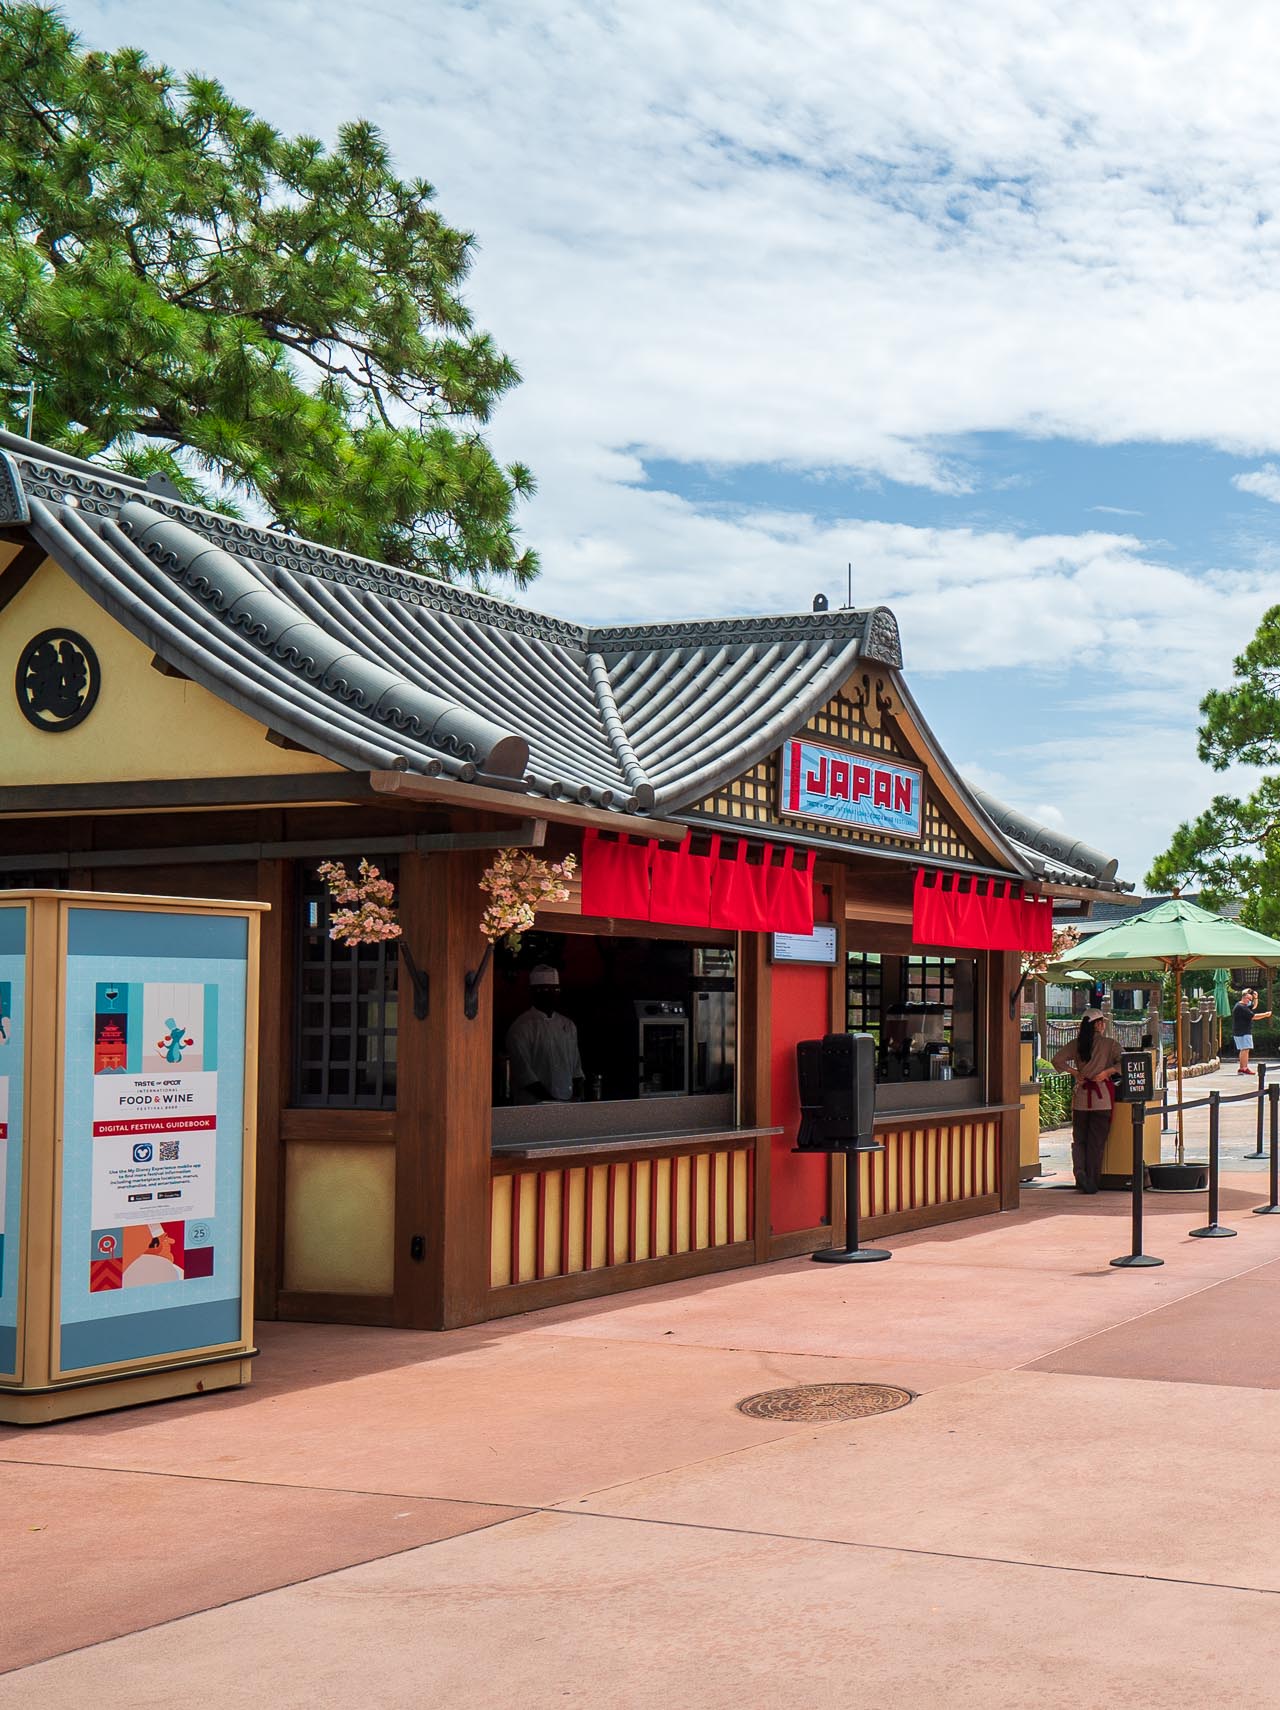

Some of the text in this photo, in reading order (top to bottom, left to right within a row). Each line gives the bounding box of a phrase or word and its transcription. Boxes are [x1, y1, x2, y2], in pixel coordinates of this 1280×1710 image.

[805, 755, 913, 815] JAPAN
[1127, 1061, 1145, 1072] EXIT
[119, 1095, 152, 1105] FOOD
[162, 1093, 194, 1103] WINE
[99, 1119, 210, 1133] DIGITAL FESTIVAL GUIDEBOOK
[194, 1229, 205, 1239] 25
